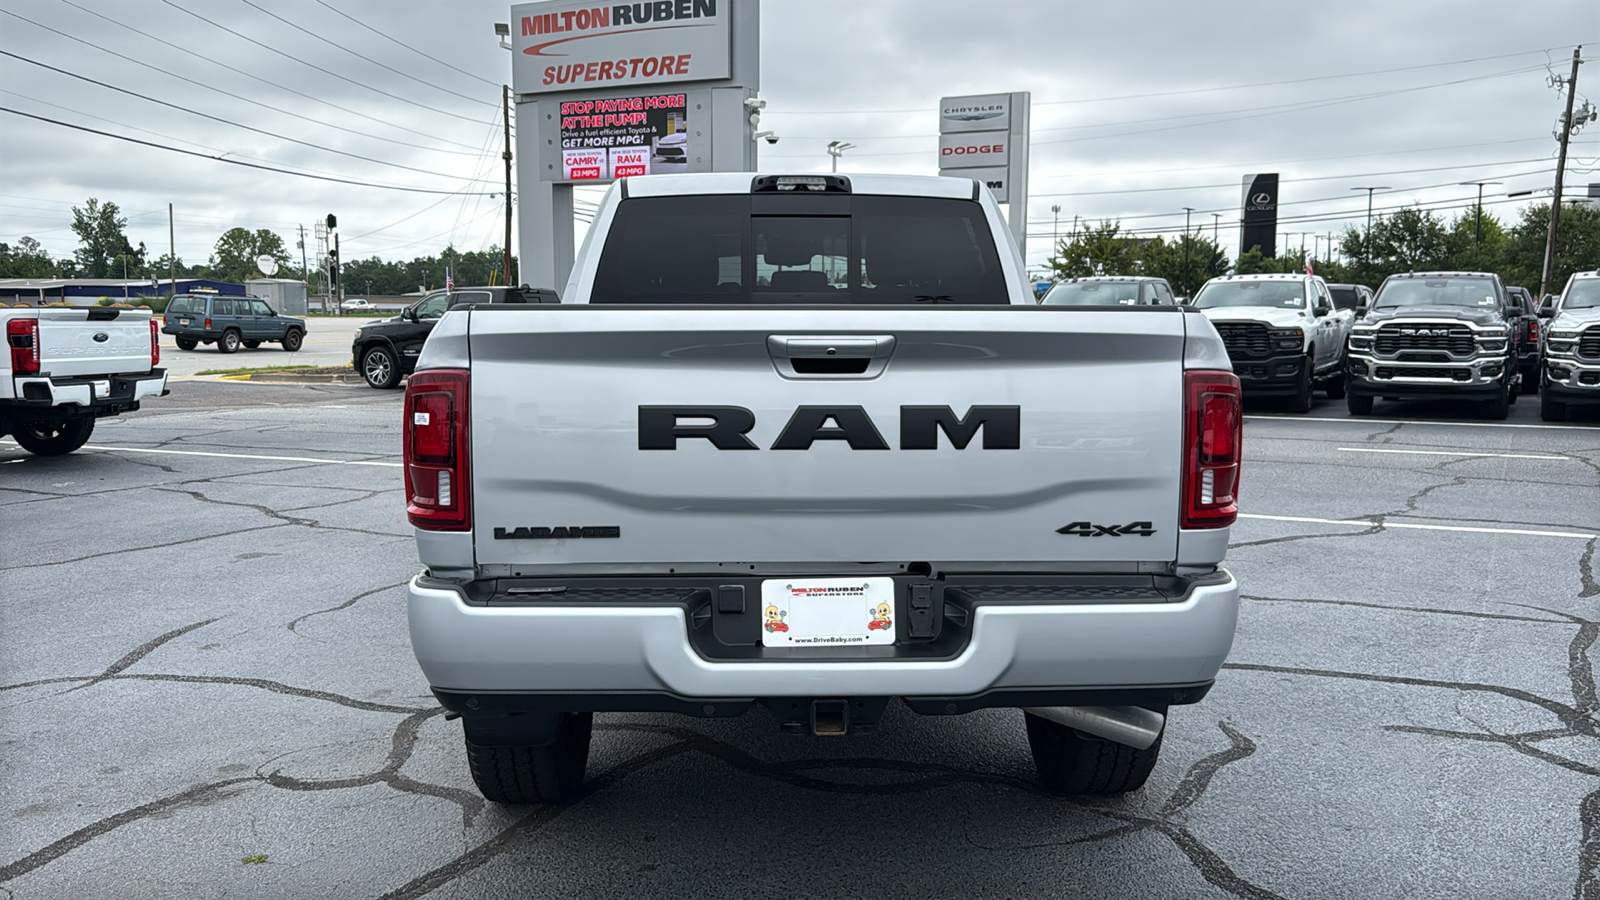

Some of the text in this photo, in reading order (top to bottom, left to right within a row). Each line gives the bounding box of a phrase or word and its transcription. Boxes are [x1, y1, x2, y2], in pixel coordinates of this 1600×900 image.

[521, 0, 717, 37] MILTON RUBEN
[542, 54, 692, 86] SUPERSTORE
[561, 94, 685, 115] STOP PAYING MORE
[944, 105, 1003, 114] CHRYSLER
[561, 112, 647, 129] AT THE PUMP!
[562, 129, 579, 138] Drive
[585, 128, 598, 137] fuel
[599, 127, 627, 136] efficient
[628, 126, 650, 136] Toyota
[562, 135, 644, 148] GET MORE MPG!
[942, 144, 1004, 156] DODGE
[565, 156, 599, 166] CAMRY
[617, 154, 642, 164] RAV4
[581, 169, 598, 177] MPG
[626, 167, 643, 175] MPG
[48, 345, 147, 356] SUPER DUTY
[638, 404, 1021, 450] RAM
[493, 525, 621, 540] LARAMIE
[1055, 521, 1158, 537] 4x4
[795, 636, 863, 644] www.DriveBaby.com
